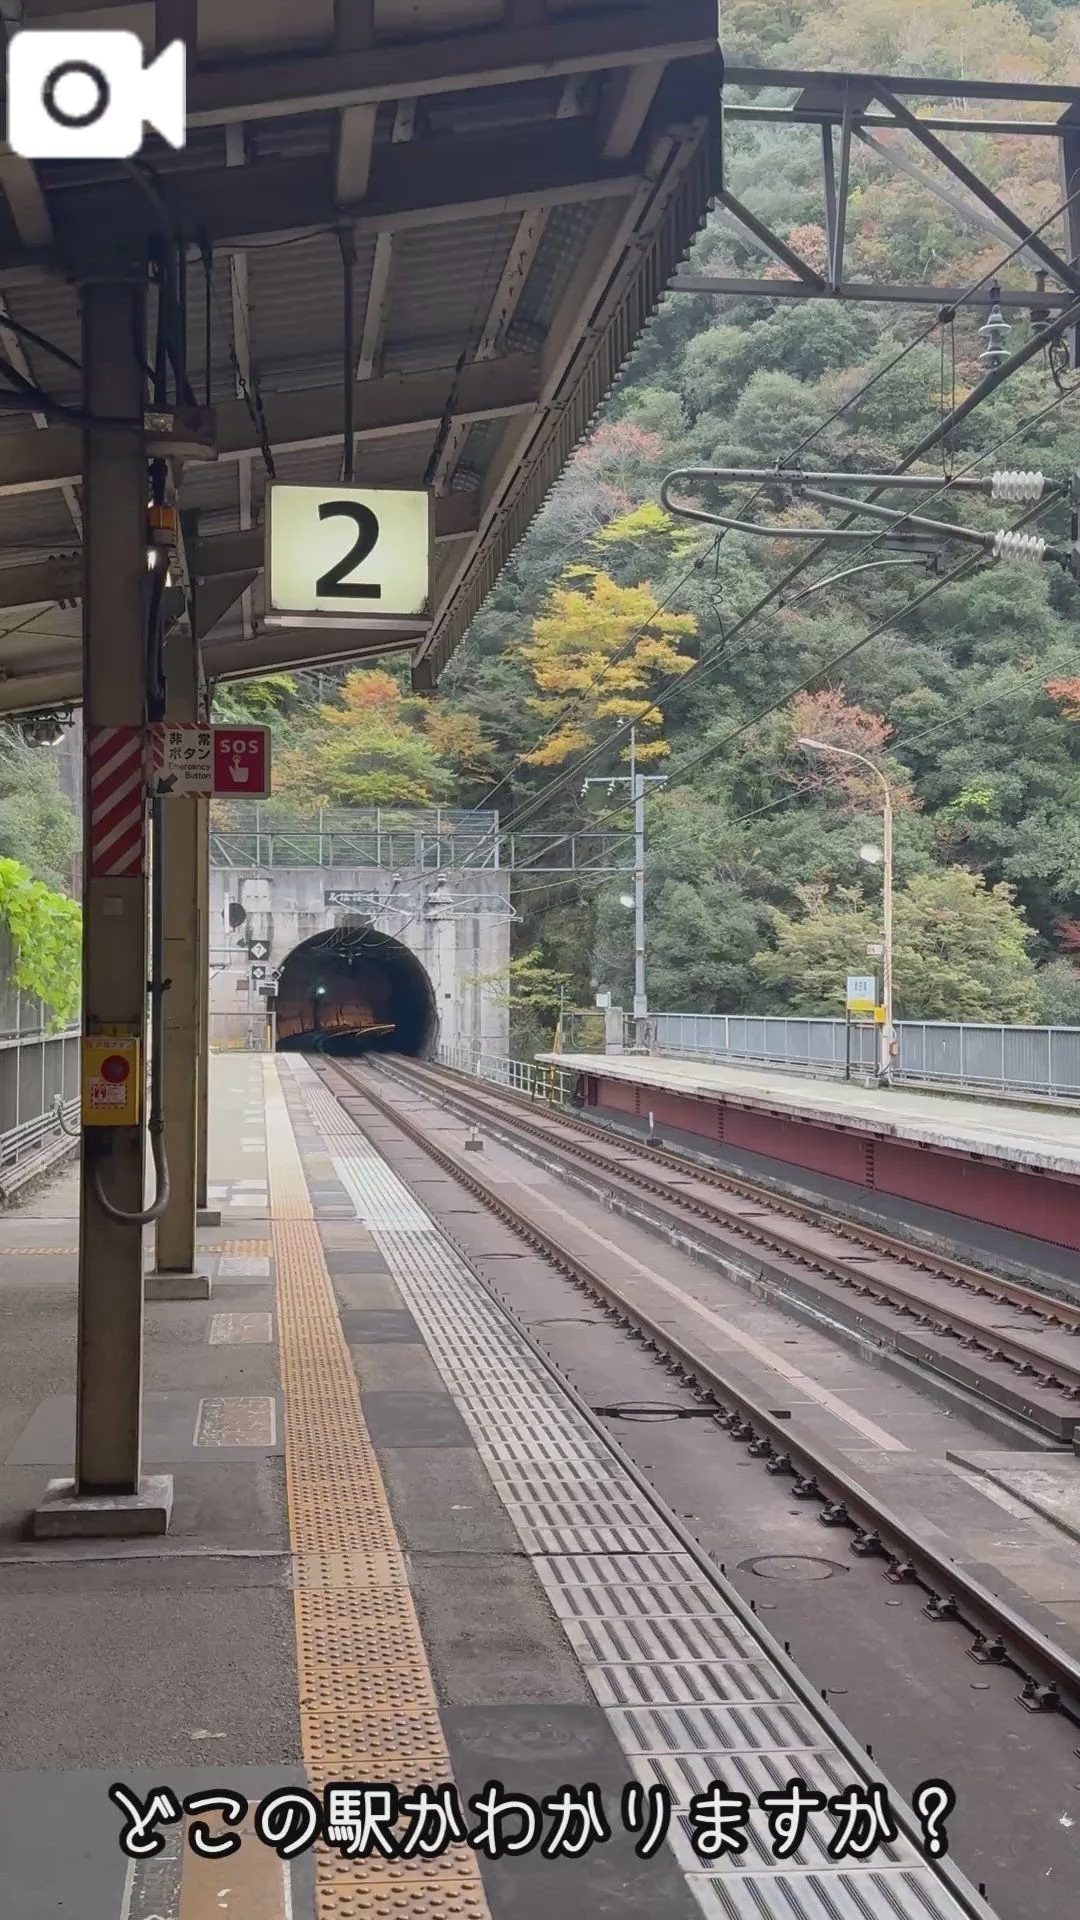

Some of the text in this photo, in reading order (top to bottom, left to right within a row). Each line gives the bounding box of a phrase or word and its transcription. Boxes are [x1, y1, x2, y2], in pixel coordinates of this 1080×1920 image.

[316, 500, 381, 599] 2
[169, 732, 211, 746] 非常
[220, 739, 259, 754] SOS
[169, 747, 211, 760] ボタン
[168, 762, 211, 771] Emergency
[185, 771, 211, 780] Button
